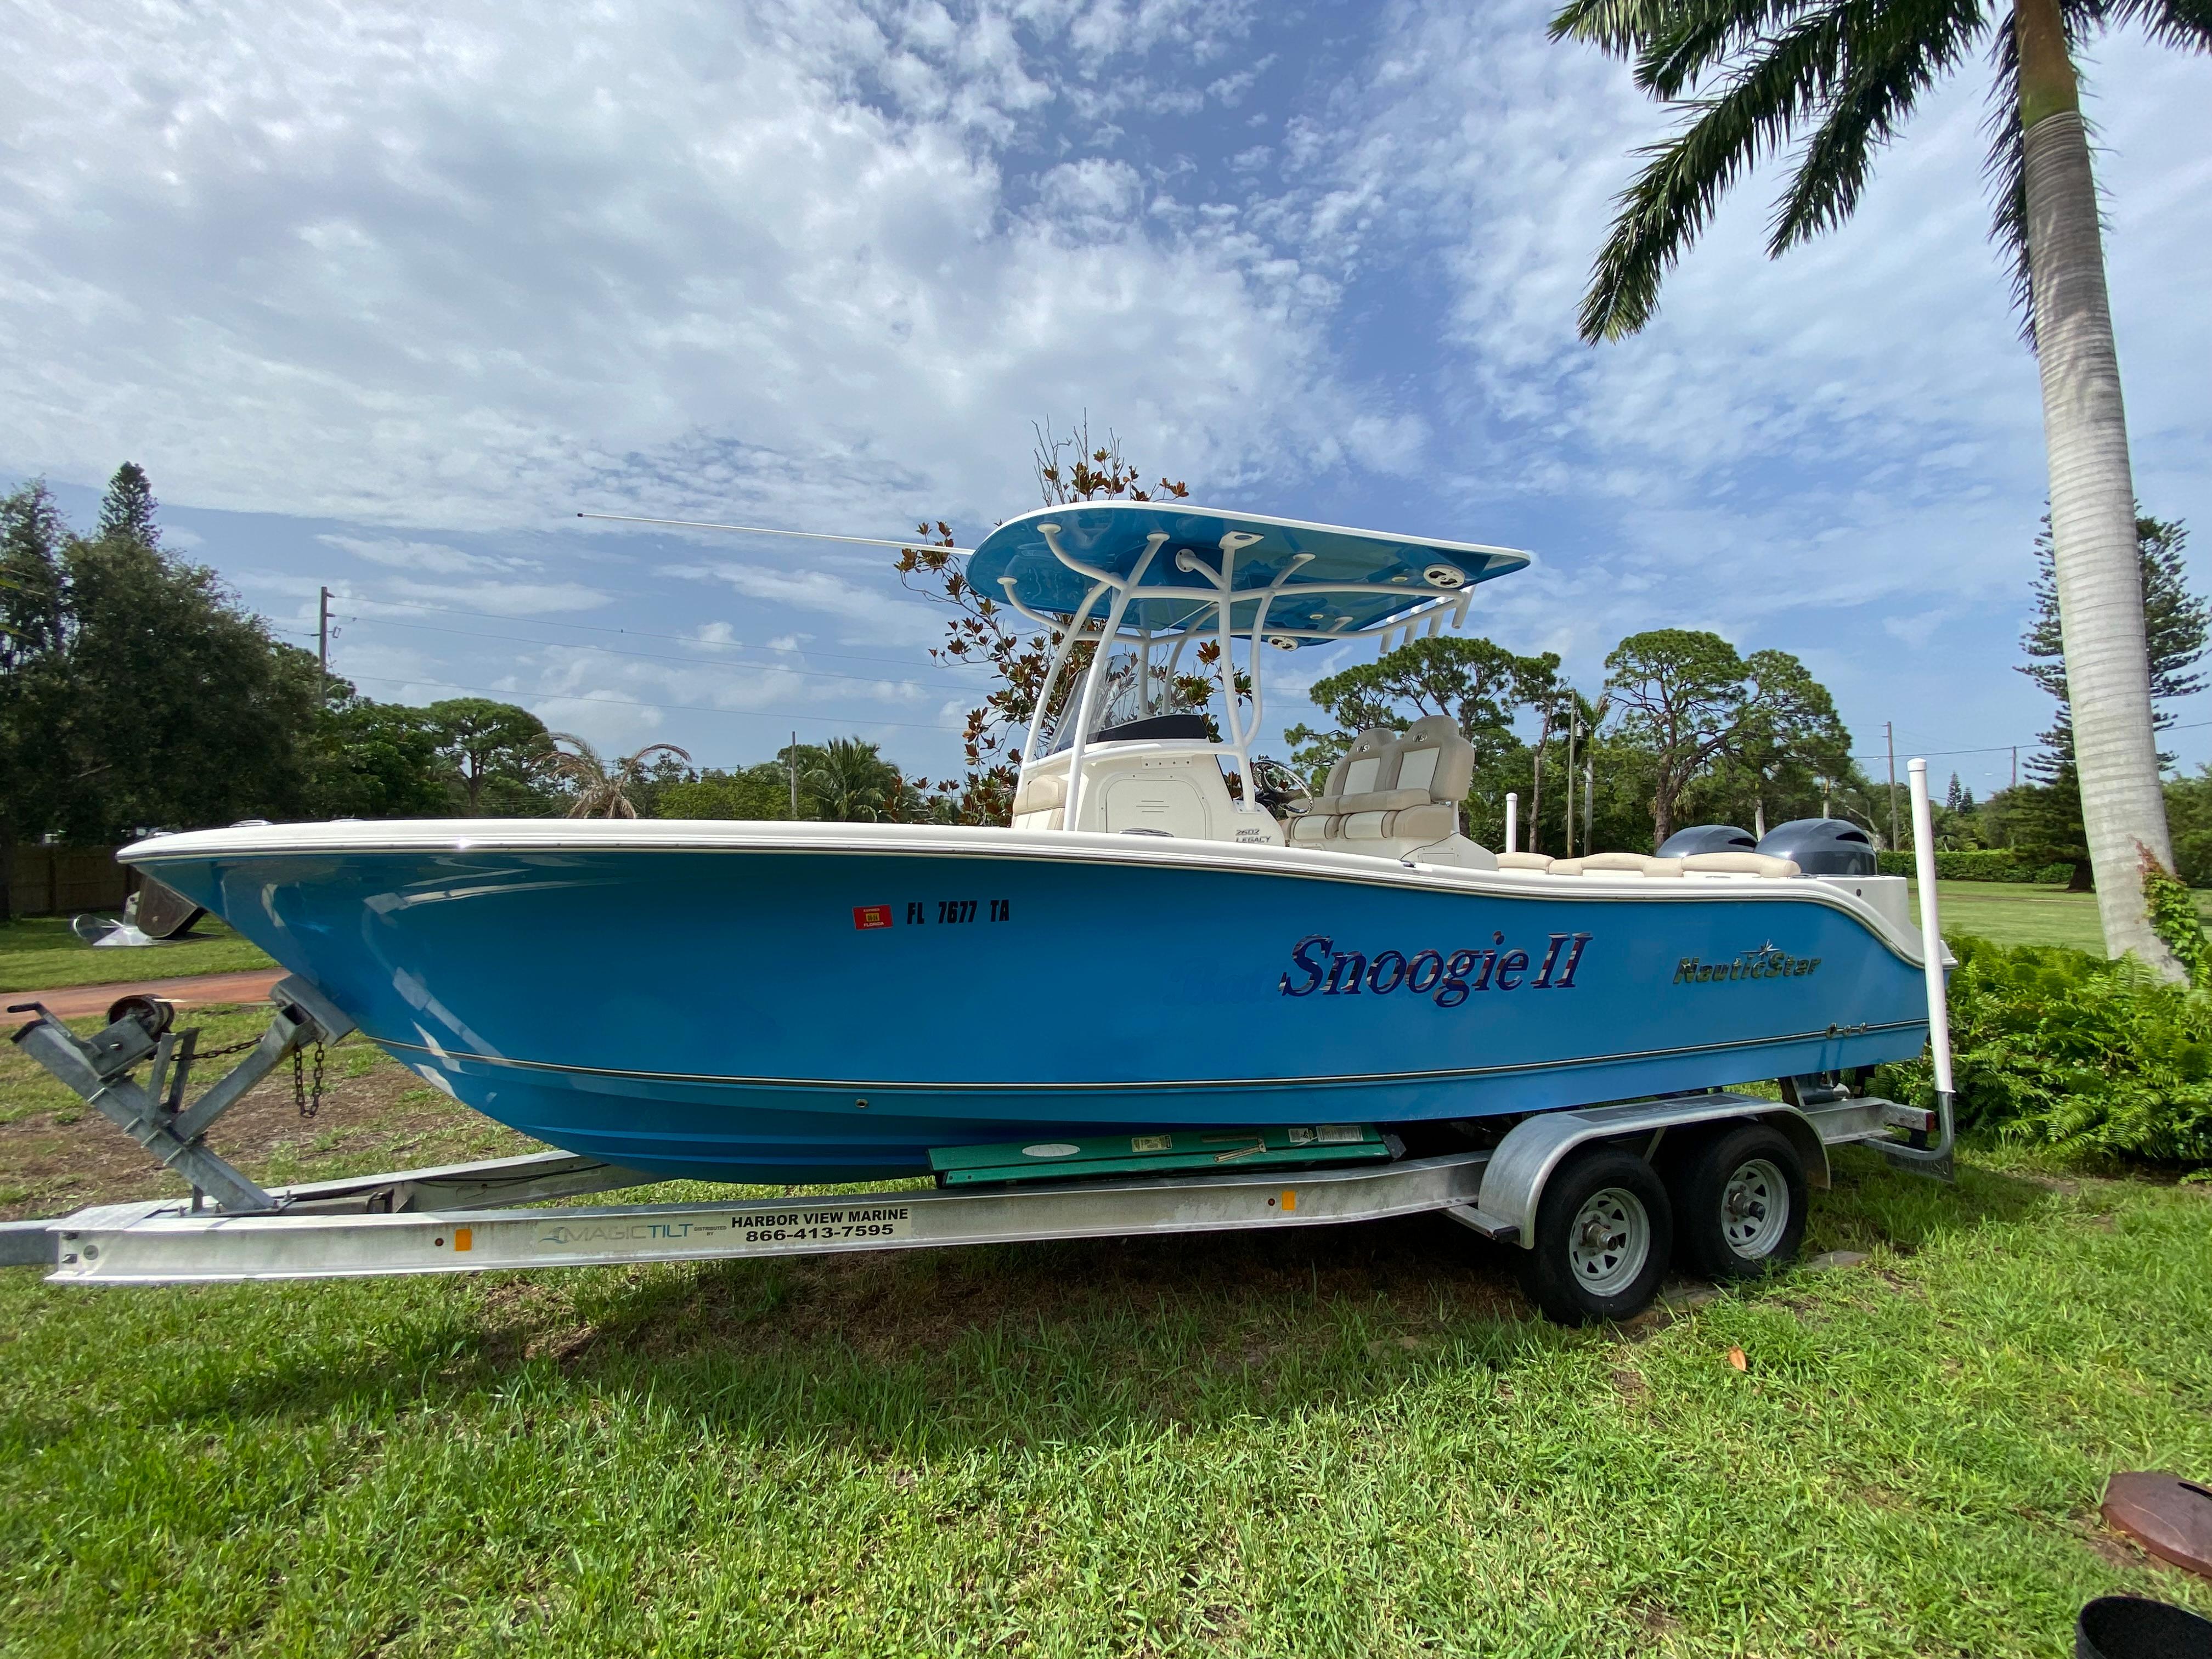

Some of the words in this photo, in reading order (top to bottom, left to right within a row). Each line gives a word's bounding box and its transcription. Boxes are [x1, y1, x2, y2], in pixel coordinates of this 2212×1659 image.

[907, 902, 925, 924] FL
[938, 900, 978, 924] 7677
[990, 899, 1009, 922] TA
[1278, 931, 1530, 1008] Snoogie
[1530, 933, 1593, 989] II
[1673, 951, 1821, 984] NauticStar
[731, 1214, 799, 1228] HARBOR
[803, 1212, 843, 1224] VIEW
[848, 1209, 909, 1222] MARINE
[746, 1224, 894, 1242] 866-413-7595
